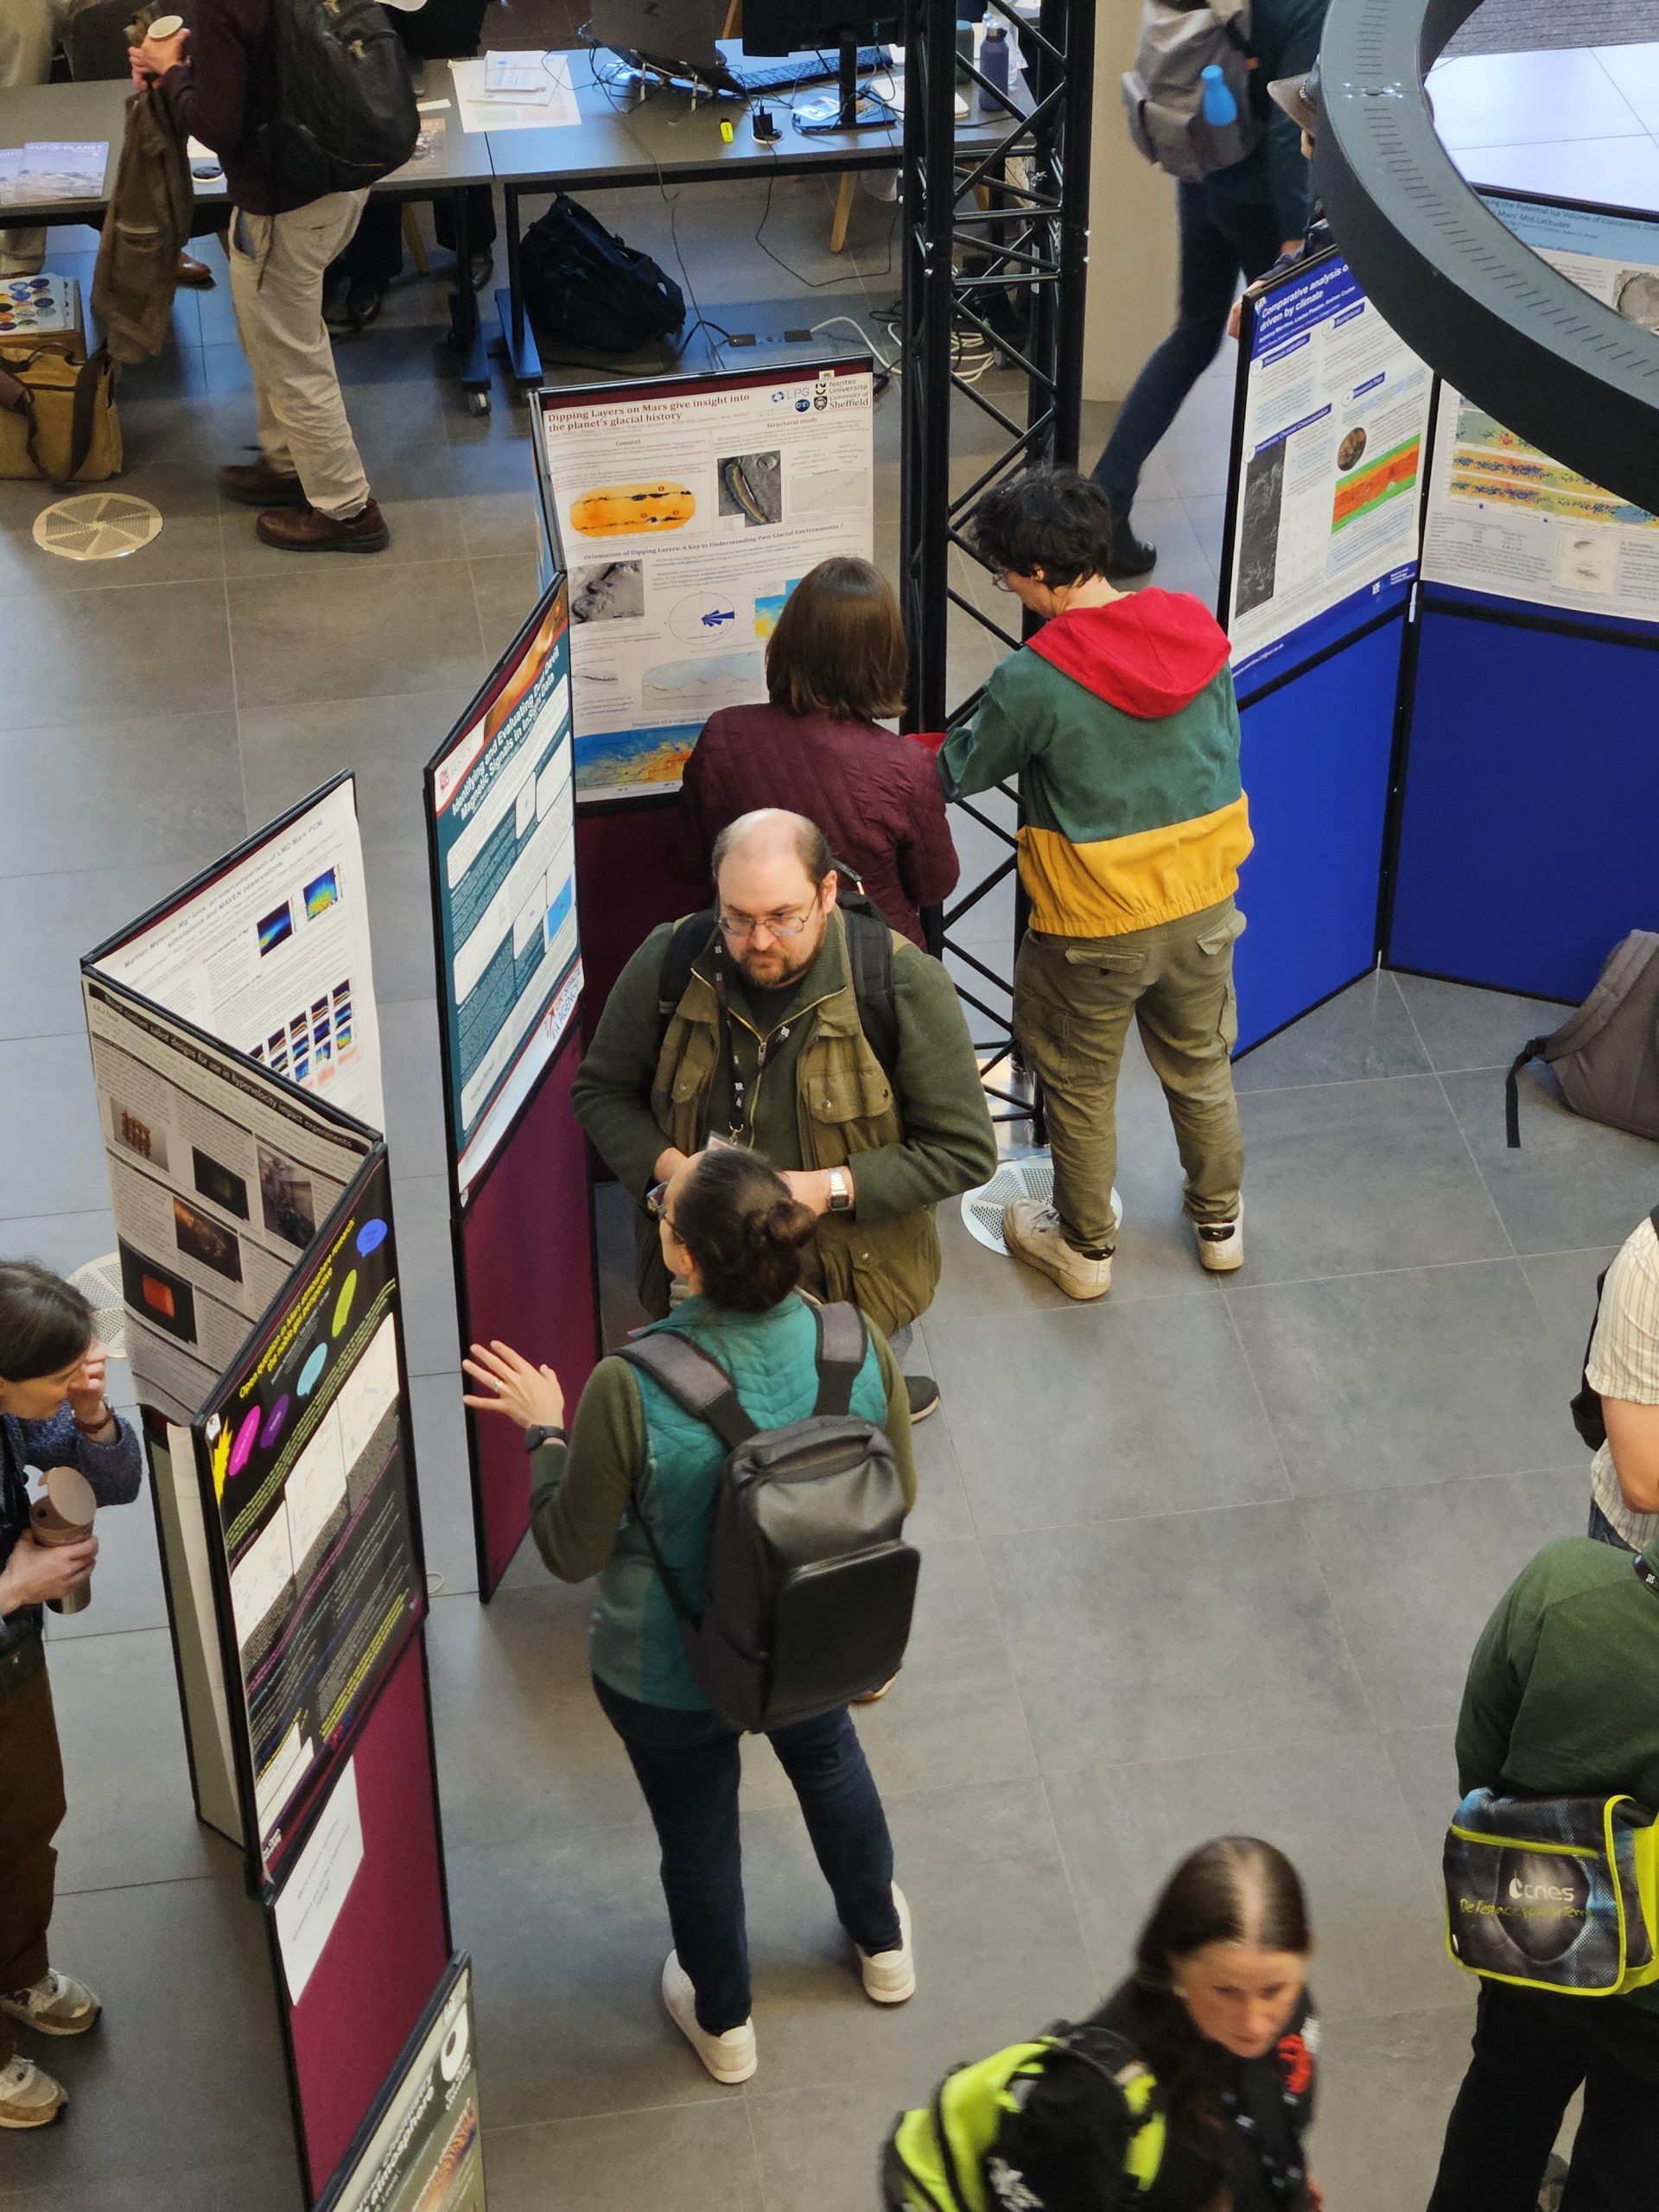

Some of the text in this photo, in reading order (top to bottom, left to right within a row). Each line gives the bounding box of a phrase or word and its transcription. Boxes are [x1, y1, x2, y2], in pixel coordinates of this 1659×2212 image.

[1516, 203, 1549, 215] Potential
[1563, 211, 1591, 222] Volume
[1601, 218, 1642, 230] Concentric
[1643, 223, 1659, 232] Crat
[1520, 213, 1571, 229] Mid-Latitudes
[1262, 285, 1309, 318] Comparative
[1309, 267, 1342, 291] analysis
[1260, 311, 1283, 332] driven
[1284, 305, 1295, 317] by
[1295, 289, 1324, 311] climate
[787, 387, 810, 400] LPG
[830, 379, 856, 388] Nantes
[830, 385, 868, 394] Université
[548, 394, 750, 423] Dipping Layers on Mars give insight into
[830, 398, 868, 410] Sheffield
[549, 423, 565, 433] the
[567, 418, 608, 434] planet's
[610, 415, 643, 429] glacial
[646, 411, 682, 423] history
[766, 416, 818, 429] Structural study
[584, 550, 622, 560] Orientation
[709, 537, 758, 550] Understanding
[758, 533, 772, 542] Past
[772, 530, 794, 541] Glacial
[795, 524, 839, 536] Environments
[452, 760, 486, 816] Identifying
[485, 739, 499, 765] and
[497, 694, 534, 746] Evaluating
[545, 645, 560, 676] Devil
[461, 772, 490, 821] Magnetic
[488, 738, 514, 776] Signals
[514, 727, 523, 742] in
[541, 671, 555, 698] Data
[168, 919, 205, 948] simulations
[219, 891, 242, 911] MAVEN
[243, 861, 283, 893] observations
[124, 948, 149, 968] Martian
[149, 927, 178, 950] Meteoric
[105, 994, 124, 1014] Novel
[124, 1009, 149, 1030] custom
[149, 1025, 170, 1043] sabot
[170, 1037, 197, 1059] designs
[197, 1052, 207, 1065] for
[208, 1062, 222, 1074] use
[232, 1072, 277, 1109] hypervelocity
[278, 1101, 303, 1124] impact
[304, 1121, 353, 1148] experiments
[302, 1267, 333, 1319] perspective
[238, 1372, 258, 1398] Open
[301, 1253, 333, 1306] atmosphere
[1460, 1898, 1474, 1914] De
[1524, 1884, 1575, 1902] cnes
